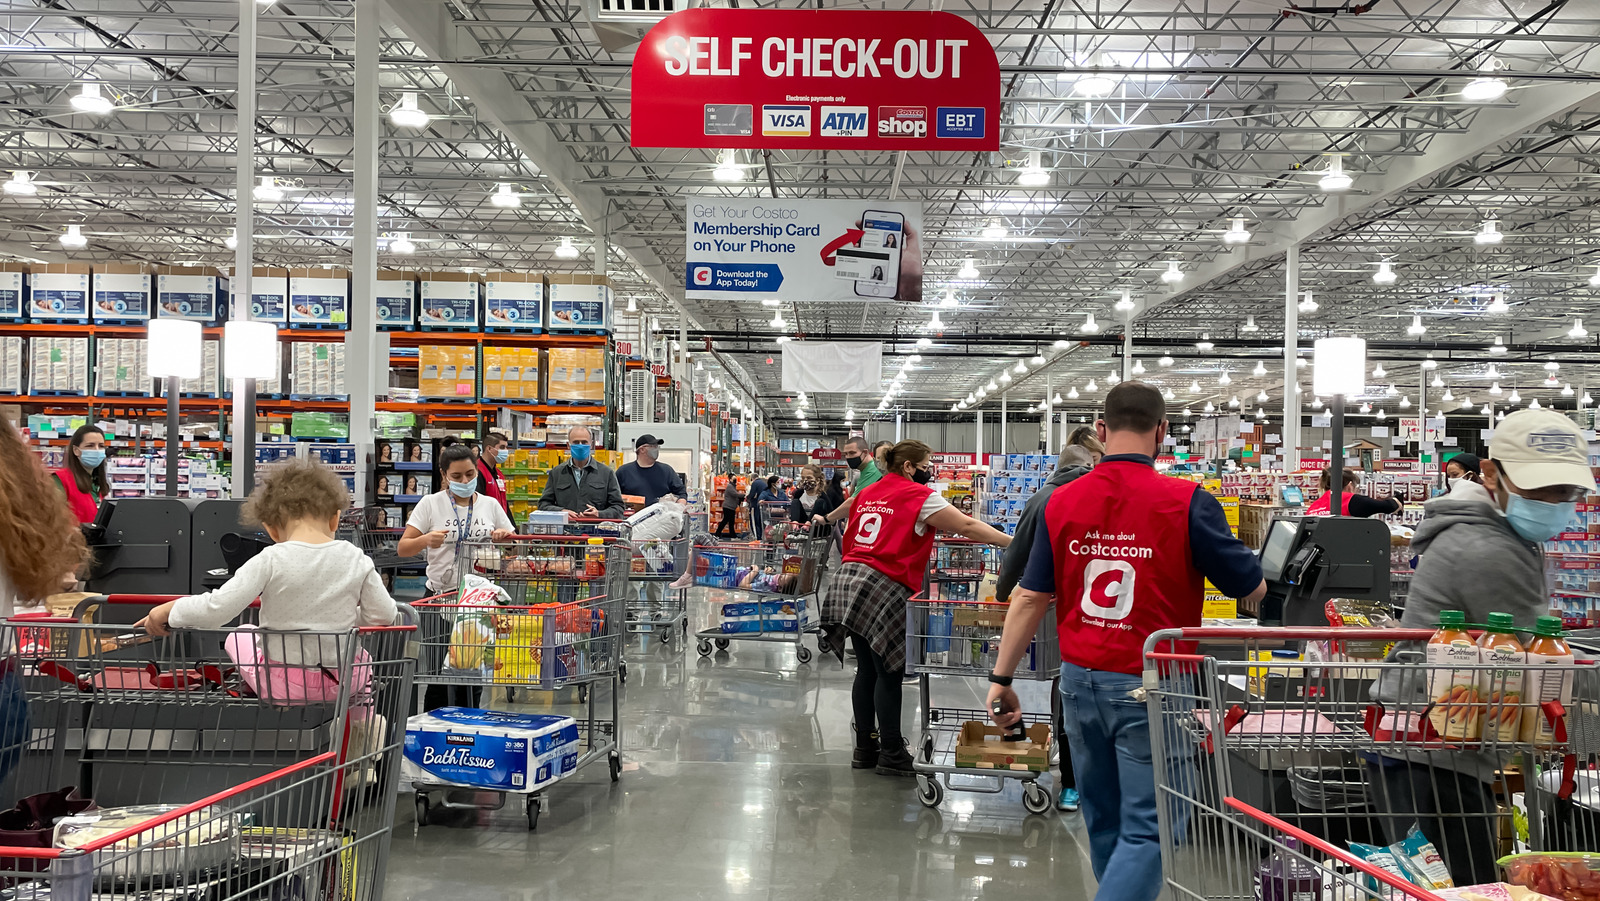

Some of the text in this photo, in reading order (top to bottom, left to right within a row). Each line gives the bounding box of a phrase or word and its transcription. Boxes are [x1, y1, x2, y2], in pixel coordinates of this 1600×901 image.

[664, 35, 969, 79] SELF CHECK-OUT
[785, 94, 810, 102] Electronic
[810, 95, 835, 103] payments
[768, 114, 805, 128] VISA
[821, 112, 867, 131] ATM
[878, 116, 927, 138] shop
[945, 113, 976, 128] EBT
[836, 129, 853, 137] +PIN
[693, 204, 799, 220] Get Your Costco
[693, 221, 821, 239] Membership Card
[693, 239, 796, 253] on Your Phone
[716, 269, 769, 278] Download the
[716, 278, 758, 288] App Today!
[616, 341, 632, 355] 300
[651, 364, 666, 376] 302
[1300, 461, 1316, 469] OICE
[444, 518, 486, 527] SOCAL
[1084, 530, 1101, 540] Ask
[1102, 533, 1116, 541] me
[1068, 539, 1153, 559] Costco.com
[1081, 616, 1105, 628] Download
[1118, 621, 1133, 631] App
[1443, 645, 1478, 656] Bolthouse
[1486, 651, 1524, 663] Bolthouse
[447, 735, 474, 743] KIRKLAND
[422, 746, 496, 769] Bath Tissue
